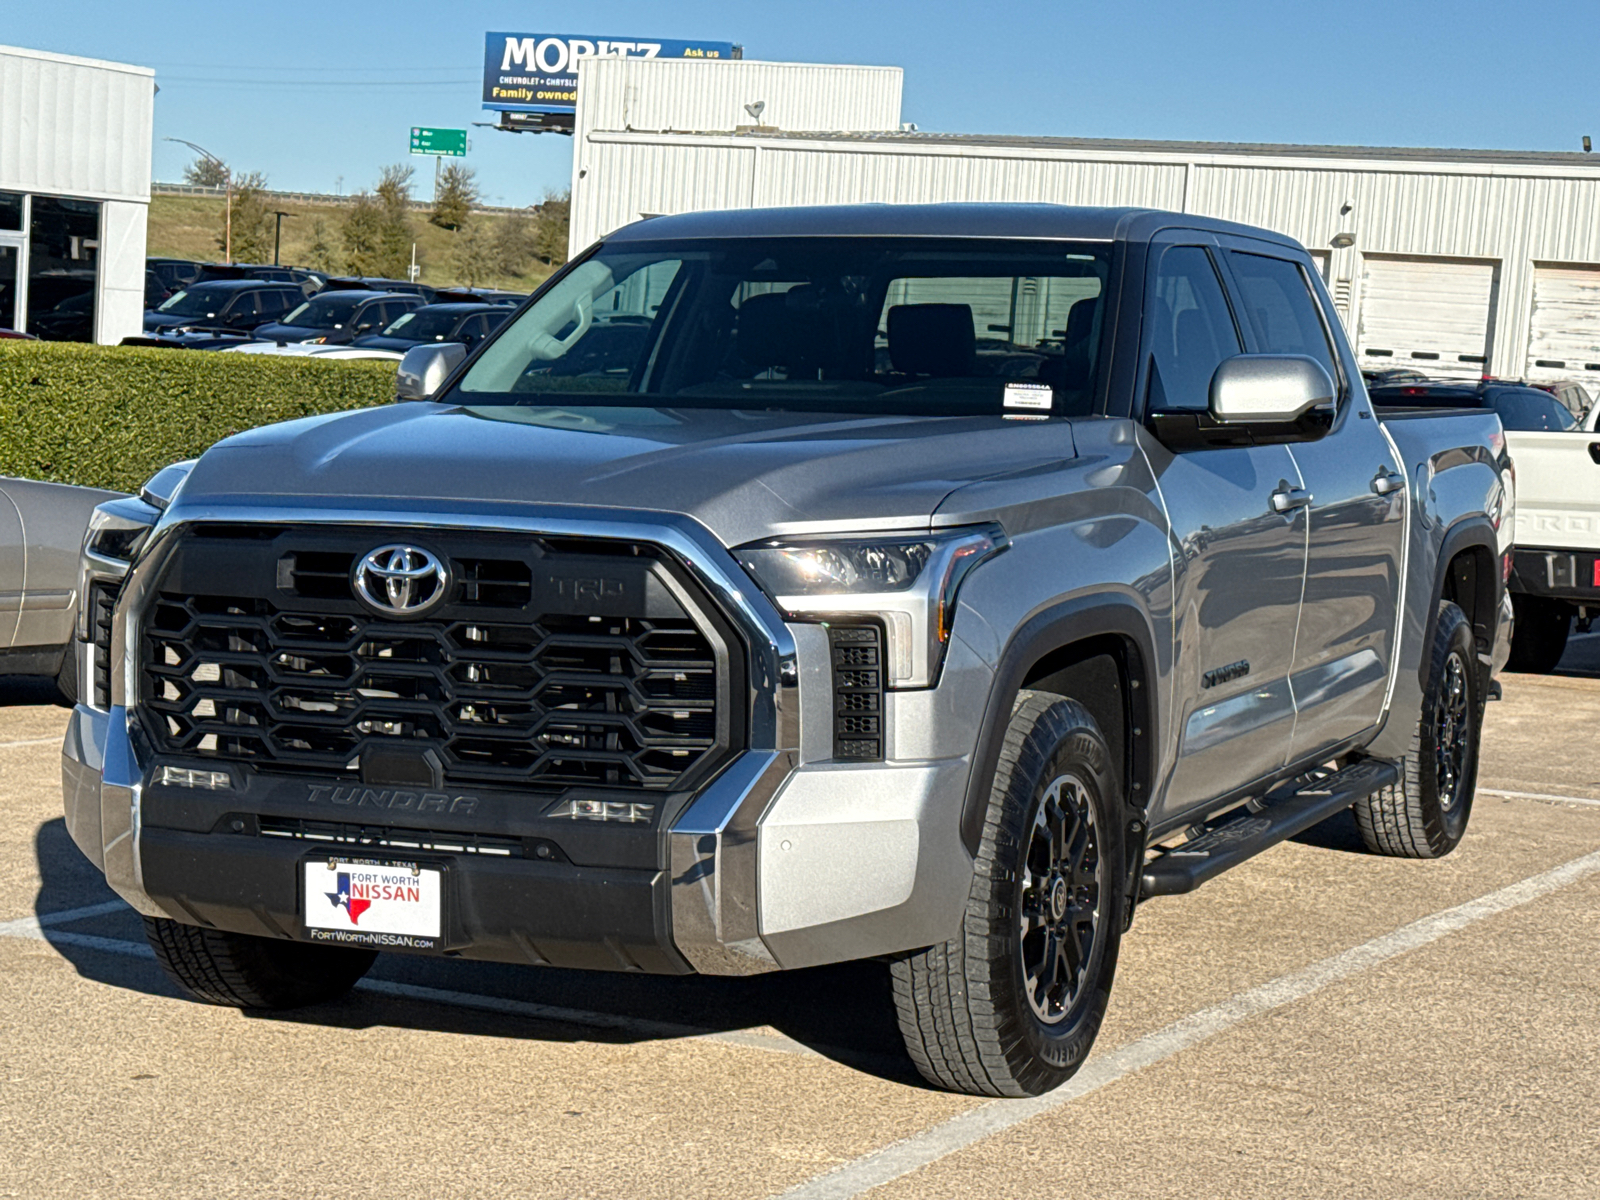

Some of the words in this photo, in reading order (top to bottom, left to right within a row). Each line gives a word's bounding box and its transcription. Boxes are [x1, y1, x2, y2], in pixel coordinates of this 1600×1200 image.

[684, 48, 704, 58] Ask
[499, 76, 540, 85] CHEVROLET
[492, 87, 534, 101] Family
[536, 90, 577, 101] owned
[307, 784, 481, 815] TUNDRA
[329, 856, 349, 864] FORT
[352, 858, 380, 866] WORTH
[392, 860, 417, 869] TEXAS
[351, 872, 378, 883] FORT
[381, 874, 420, 886] WORTH
[352, 883, 420, 903] NISSAN
